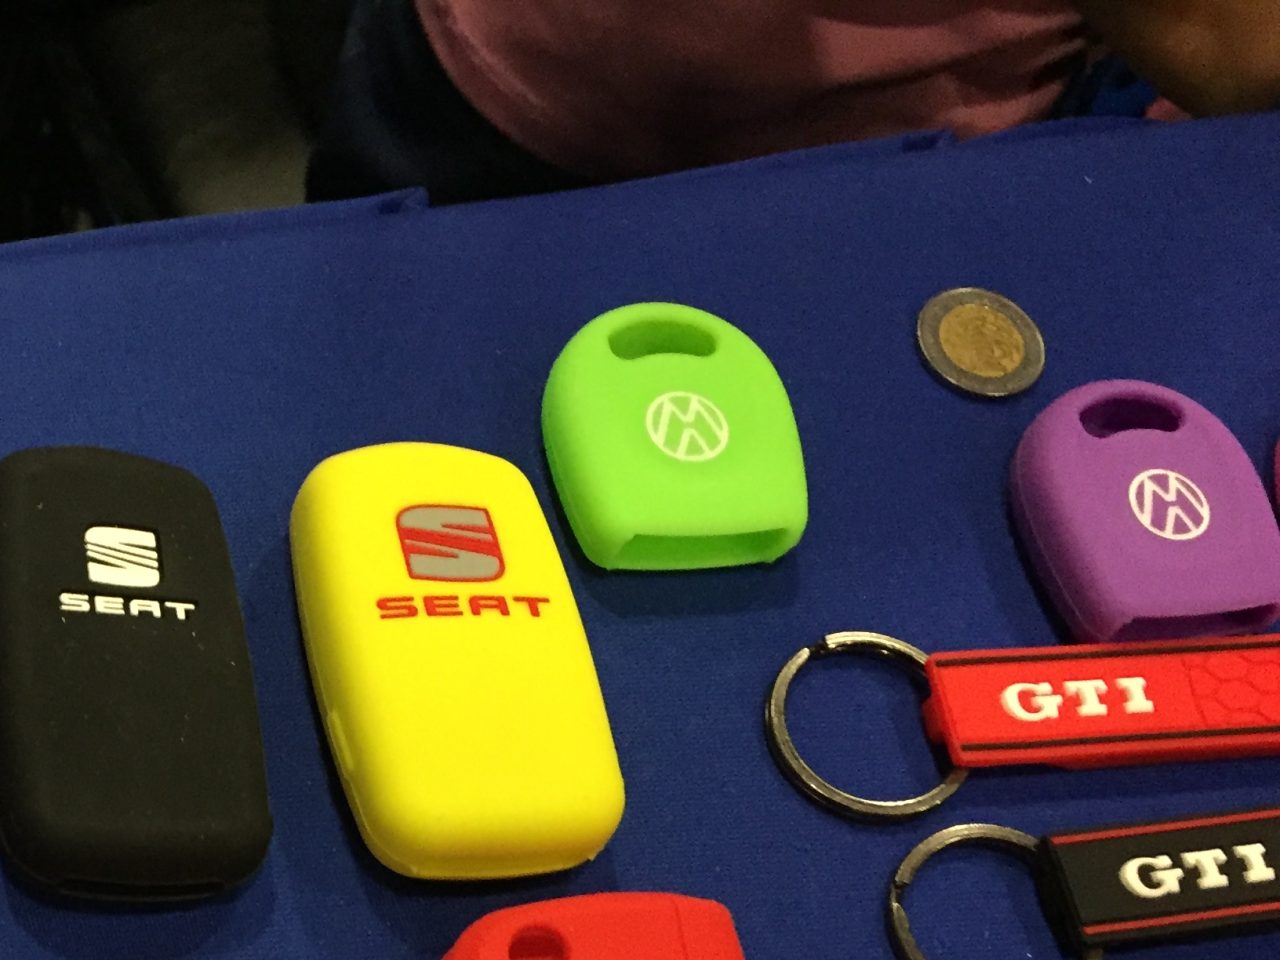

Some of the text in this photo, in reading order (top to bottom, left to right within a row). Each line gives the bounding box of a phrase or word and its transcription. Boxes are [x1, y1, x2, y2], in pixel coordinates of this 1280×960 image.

[59, 592, 195, 620] SEAT
[376, 594, 550, 619] SEAT
[1000, 676, 1155, 722] GTI
[1119, 843, 1276, 898] GTI
